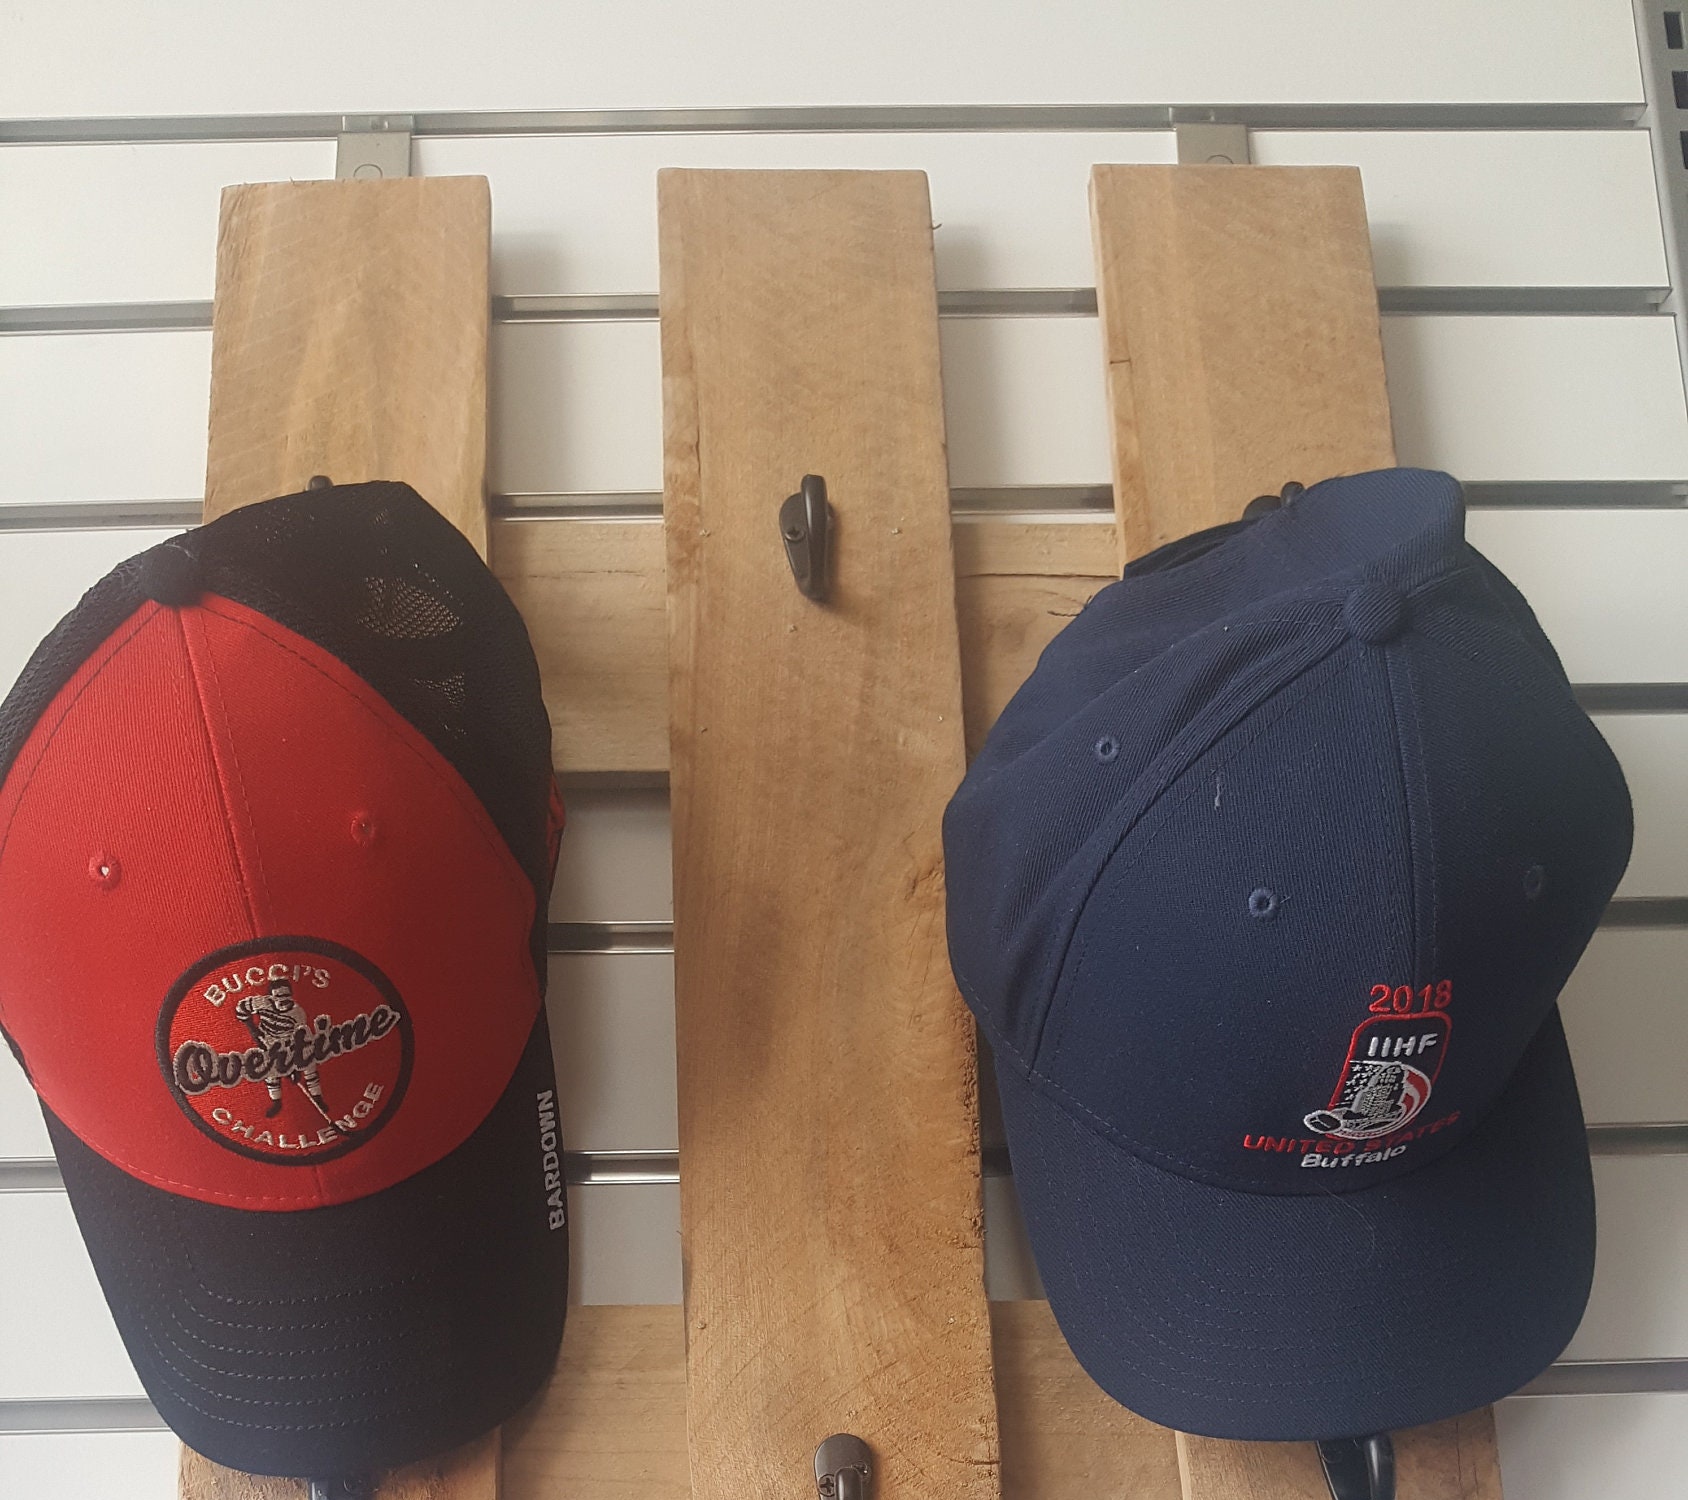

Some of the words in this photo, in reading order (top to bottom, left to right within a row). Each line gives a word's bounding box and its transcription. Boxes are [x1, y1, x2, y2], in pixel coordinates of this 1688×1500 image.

[203, 963, 331, 1008] BUCCI'S
[1368, 979, 1453, 1014] 2018
[172, 1004, 401, 1095] Overtime
[1367, 1033, 1439, 1057] IIHF
[211, 1082, 385, 1149] CHALLENGE
[1243, 1133, 1355, 1155] UNITED
[1363, 1110, 1462, 1152] STATES
[536, 1090, 566, 1231] BARDOWN
[1300, 1144, 1408, 1168] Buffalo
